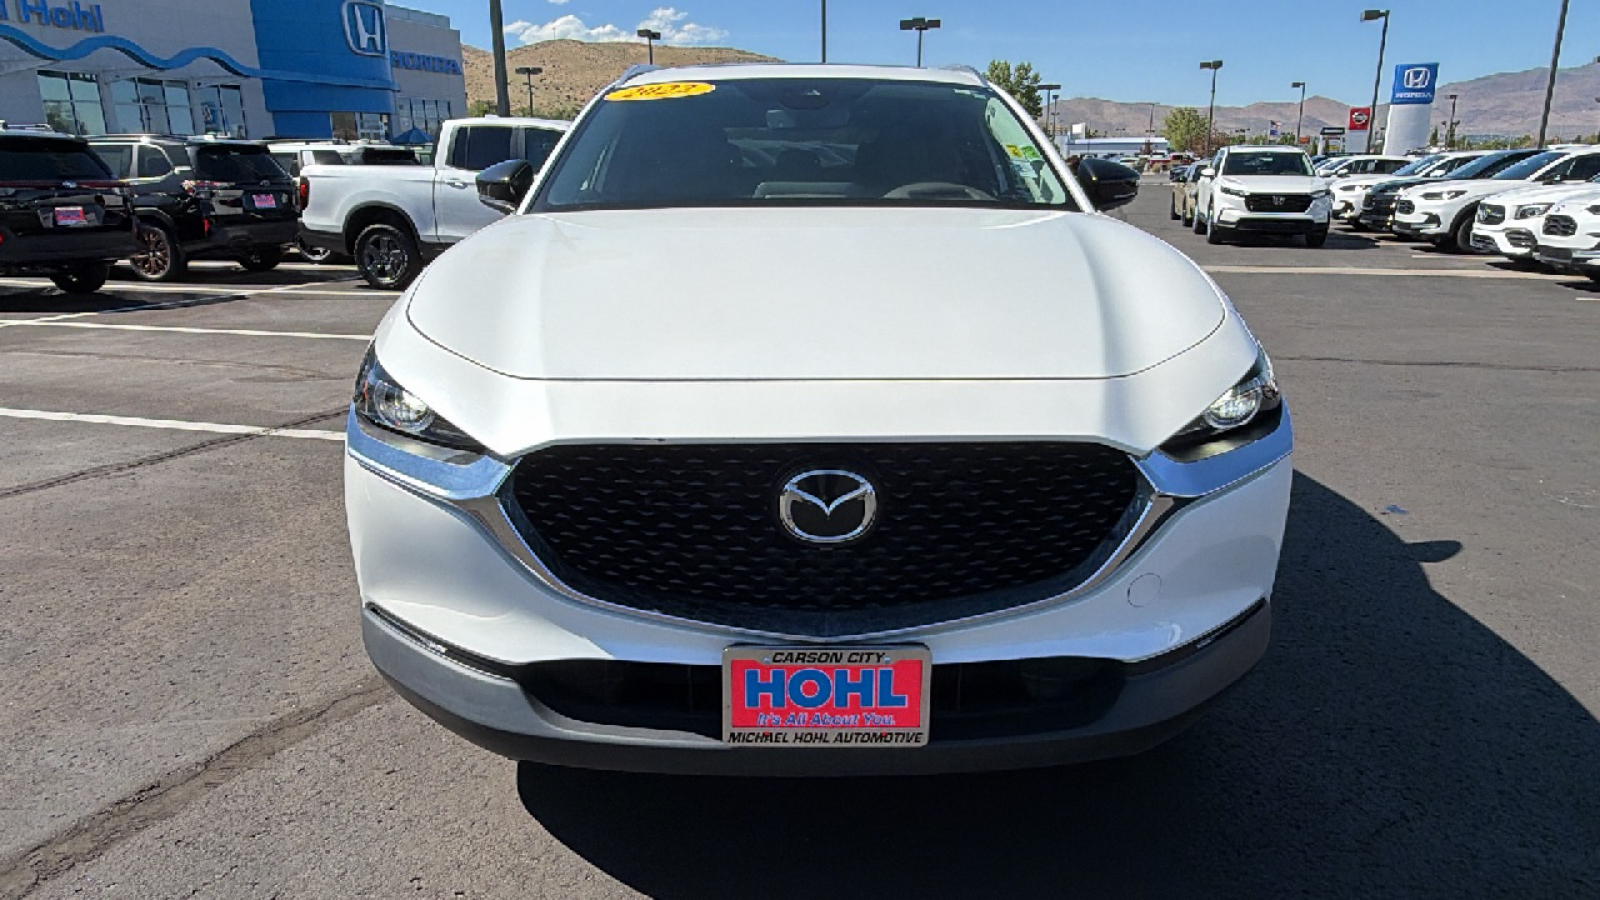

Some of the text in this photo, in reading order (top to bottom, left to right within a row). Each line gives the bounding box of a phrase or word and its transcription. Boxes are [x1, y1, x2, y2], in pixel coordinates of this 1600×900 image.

[20, 0, 105, 32] Hohl
[390, 49, 462, 75] HONDA
[772, 651, 886, 664] CARSON CITY
[744, 667, 908, 709] HOHL
[757, 711, 895, 726] It's All About You.
[727, 731, 924, 744] MICHAEL HOHL AUTOMOTIVE
